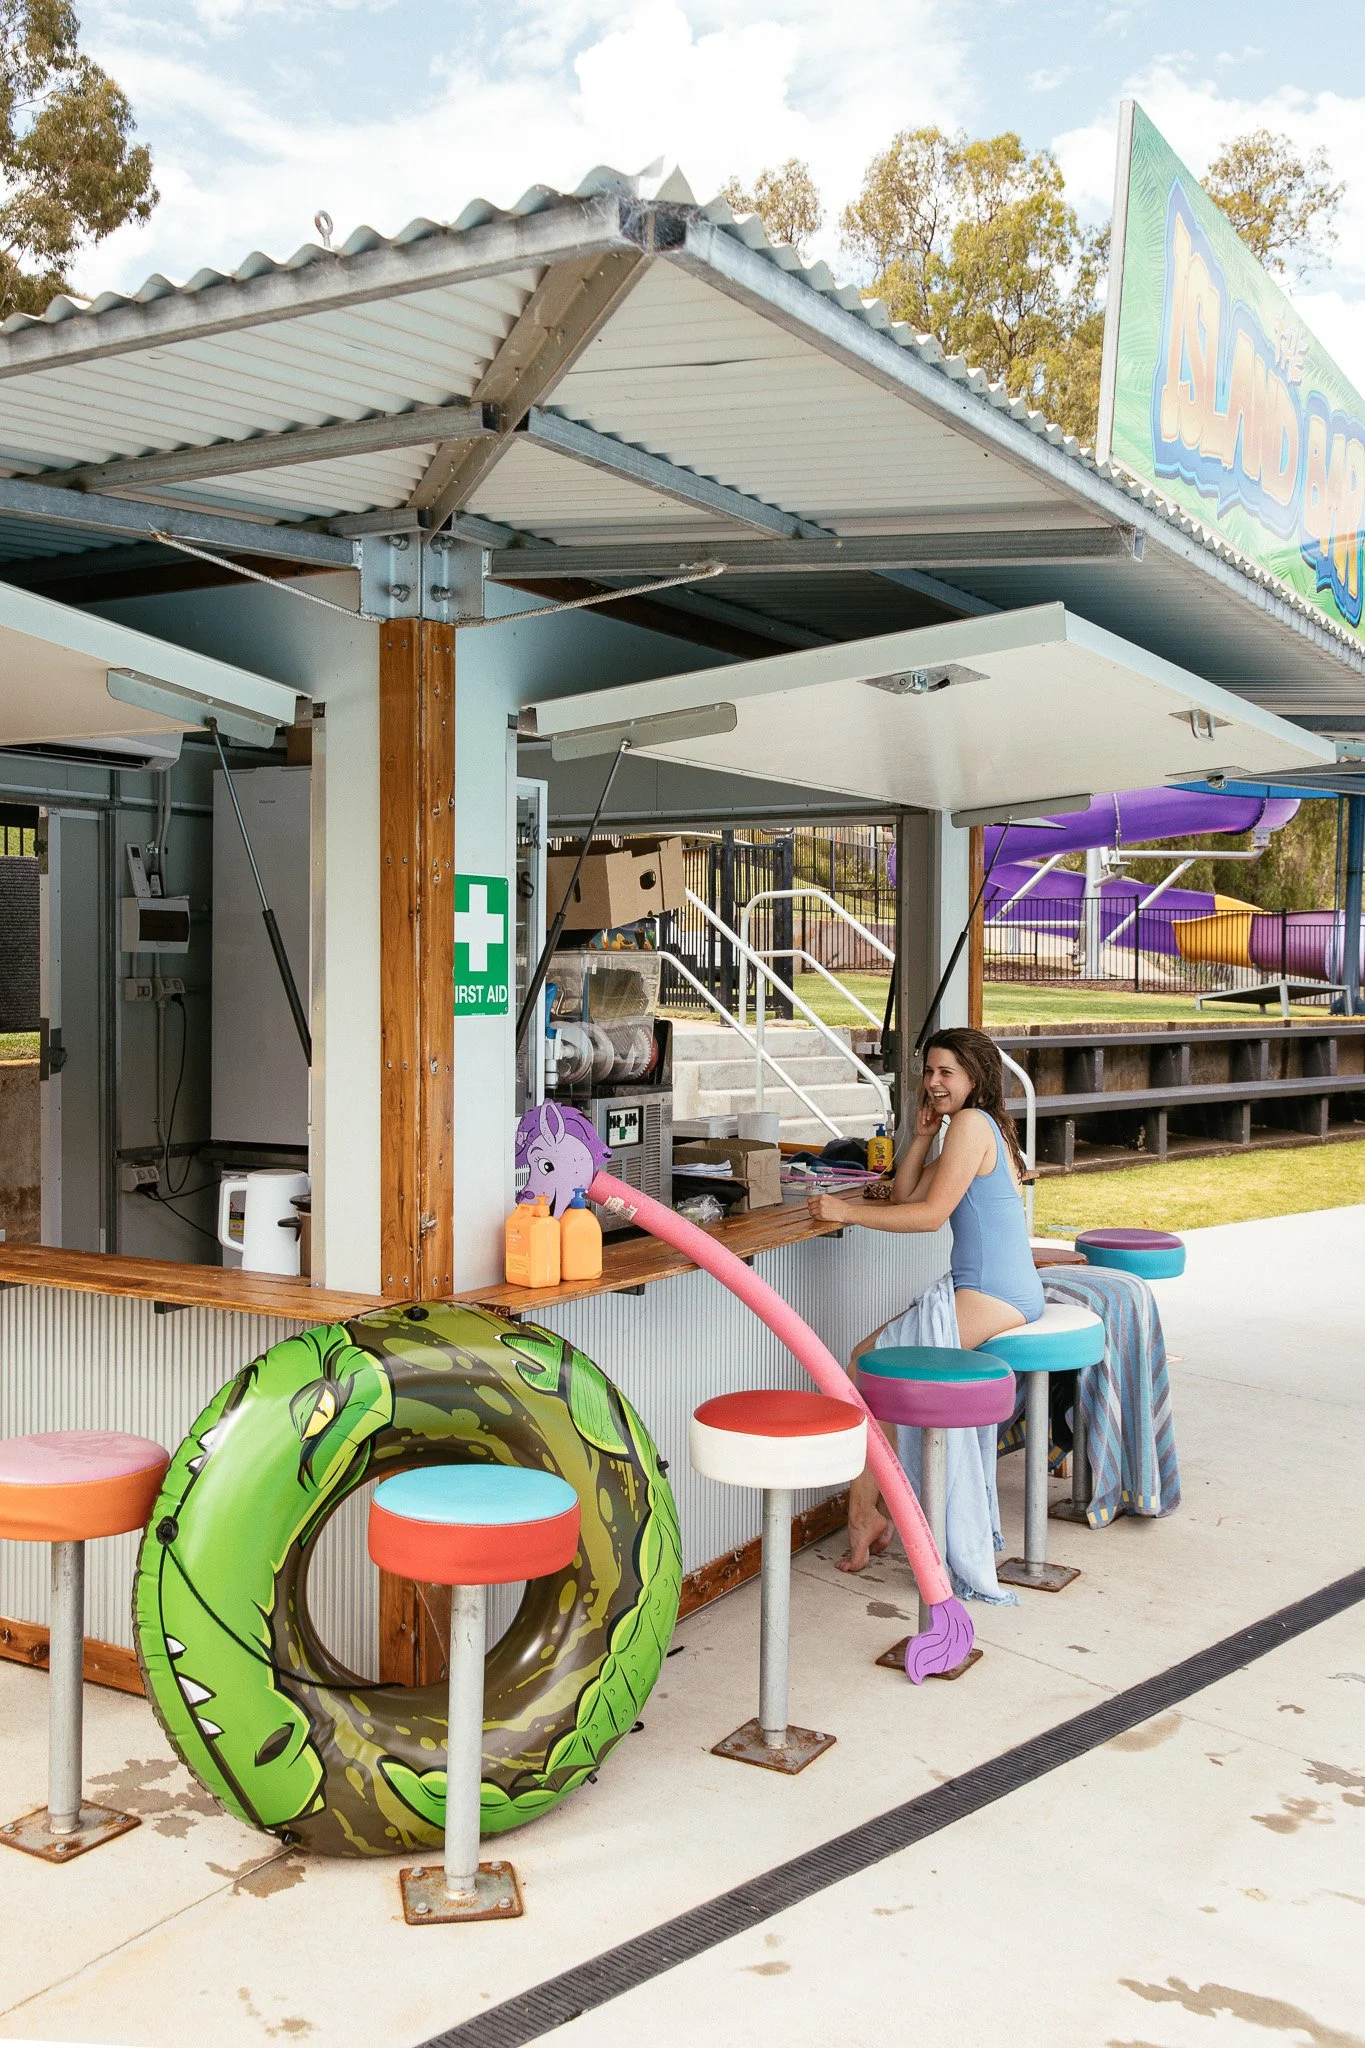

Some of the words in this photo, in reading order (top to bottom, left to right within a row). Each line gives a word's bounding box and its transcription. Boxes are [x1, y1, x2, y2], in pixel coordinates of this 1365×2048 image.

[1273, 301, 1309, 386] THE
[1161, 212, 1298, 506] ISLAND
[1304, 414, 1365, 600] BAR
[455, 984, 484, 1004] IRST
[486, 984, 508, 1003] AID
